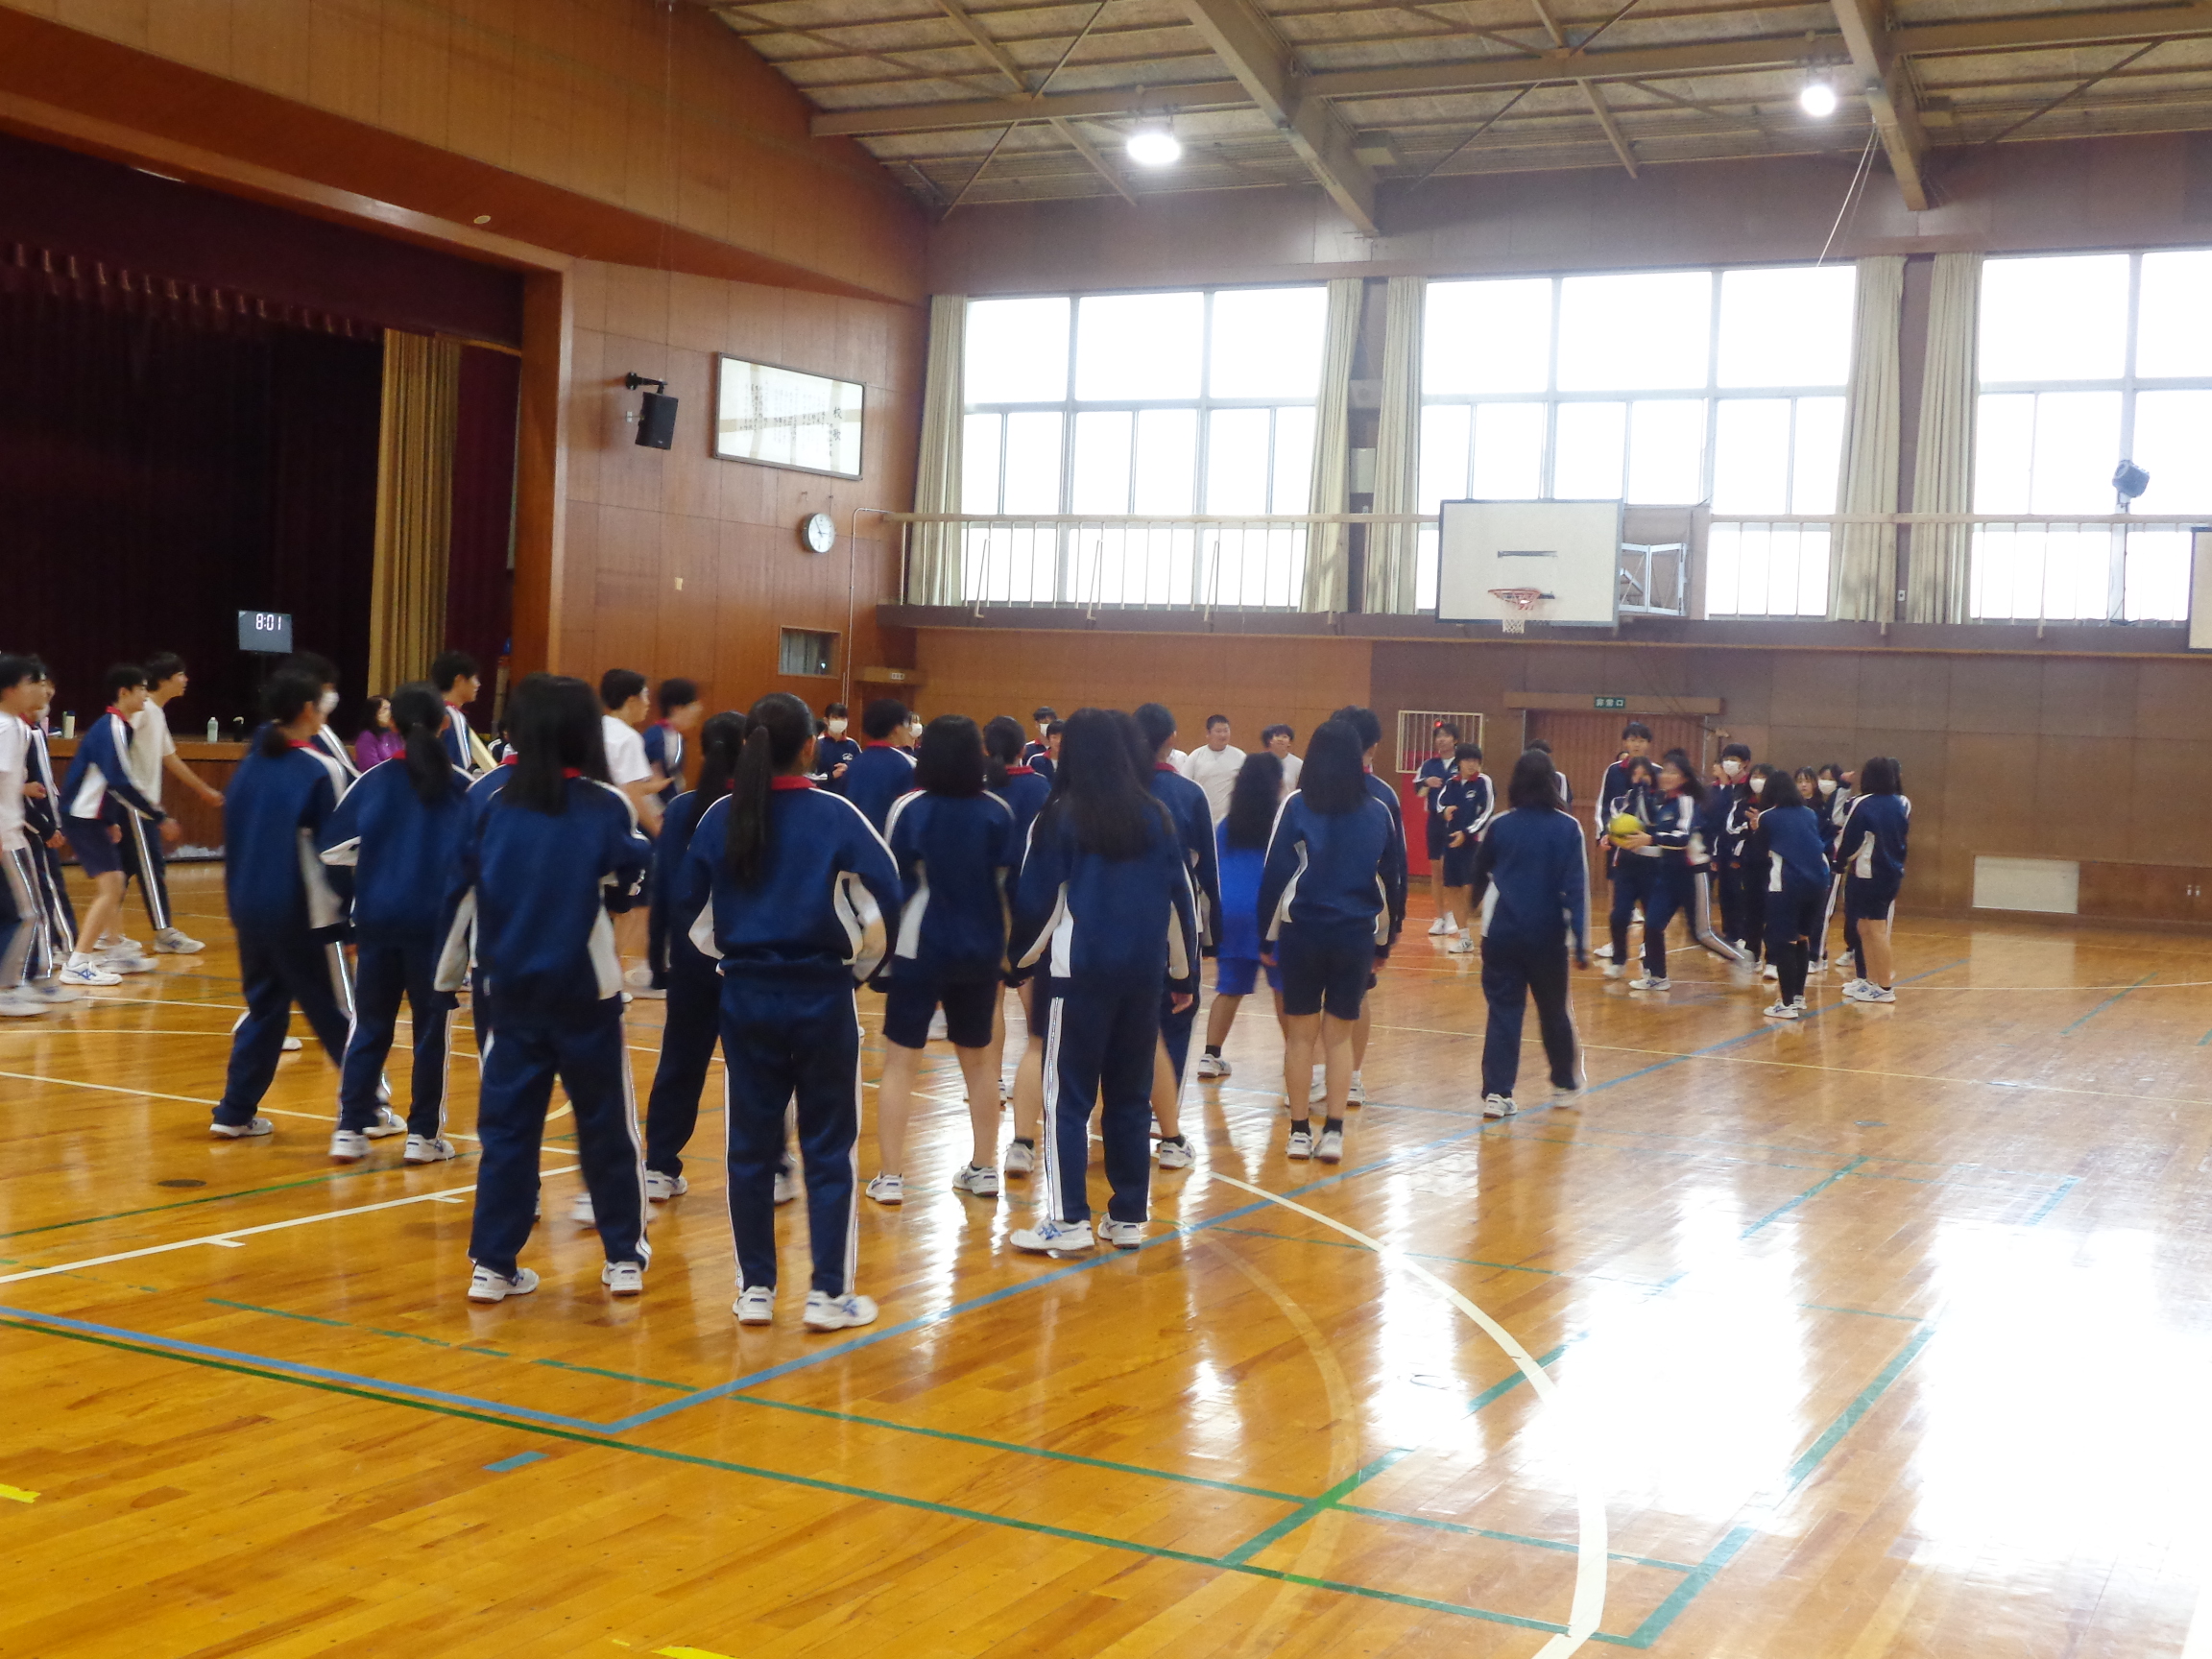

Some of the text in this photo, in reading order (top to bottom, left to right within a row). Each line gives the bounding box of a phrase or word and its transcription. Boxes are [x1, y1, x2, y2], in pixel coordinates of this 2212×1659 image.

[832, 406, 843, 442] 校歌
[255, 613, 282, 631] 8:01
[1596, 698, 1623, 708] 非常口
